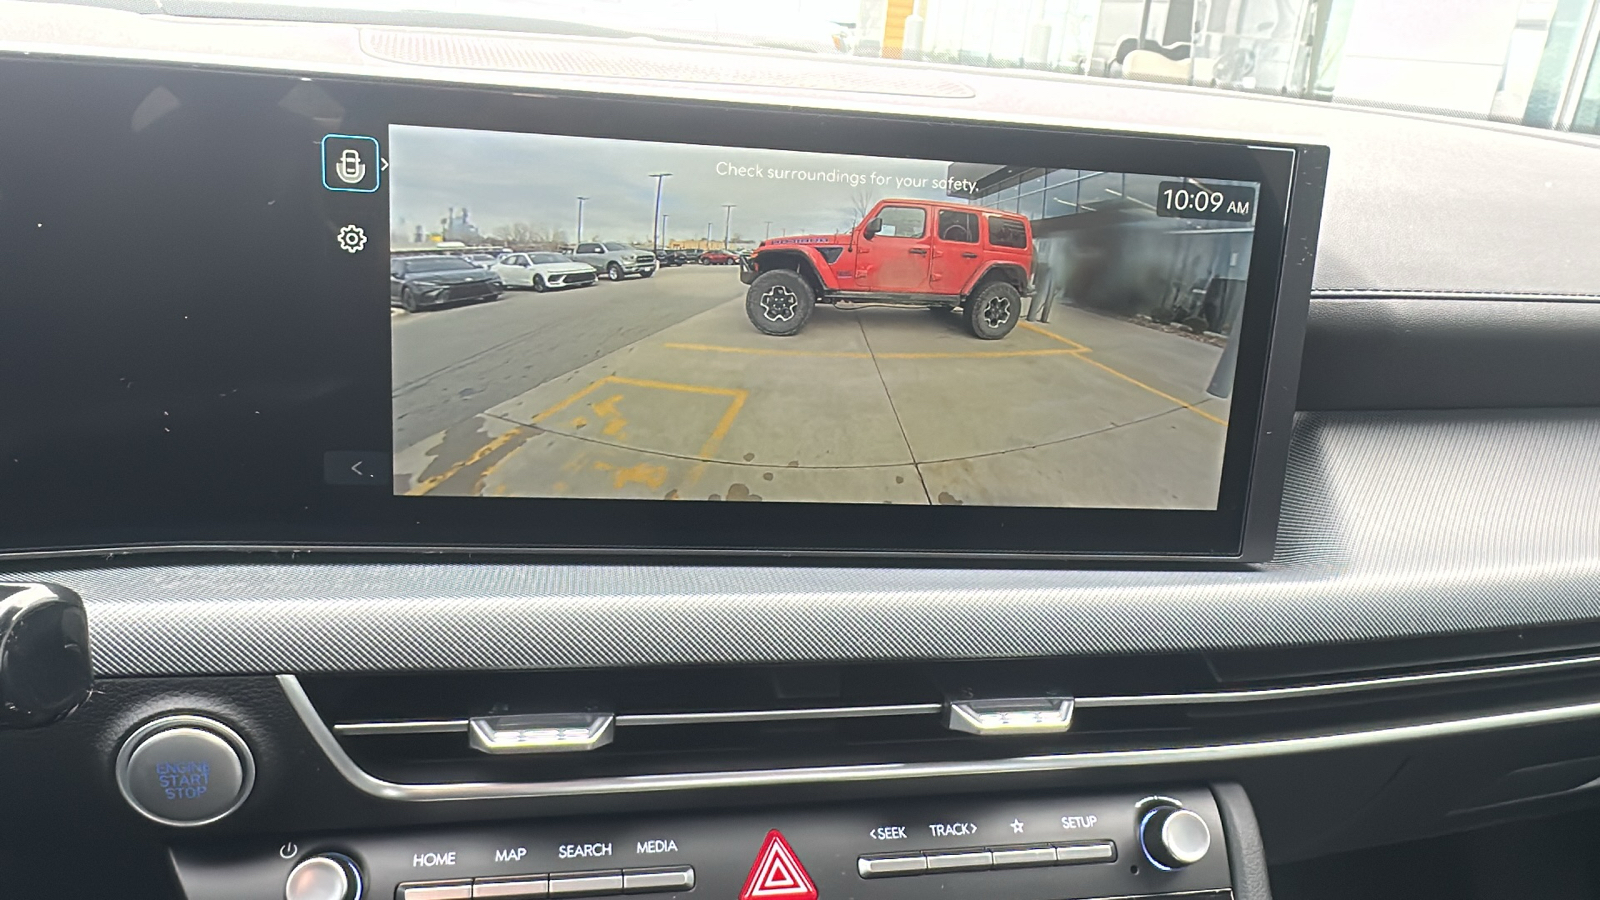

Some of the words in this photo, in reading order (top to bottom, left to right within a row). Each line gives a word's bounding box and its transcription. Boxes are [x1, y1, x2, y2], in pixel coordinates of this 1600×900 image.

[716, 161, 763, 178] Check
[767, 168, 867, 187] surroundings
[870, 171, 892, 186] for
[895, 176, 928, 189] your
[931, 176, 980, 193] safety.
[1163, 188, 1224, 213] 10:09
[1226, 200, 1250, 214] AM
[156, 761, 210, 774] ENGINE
[159, 773, 209, 787] START
[165, 786, 207, 799] STOP
[1061, 815, 1097, 829] SETUP
[558, 842, 612, 858] SEARCH
[636, 839, 678, 854] MEDIA
[413, 851, 456, 867] HOME
[495, 847, 527, 862] MAP
